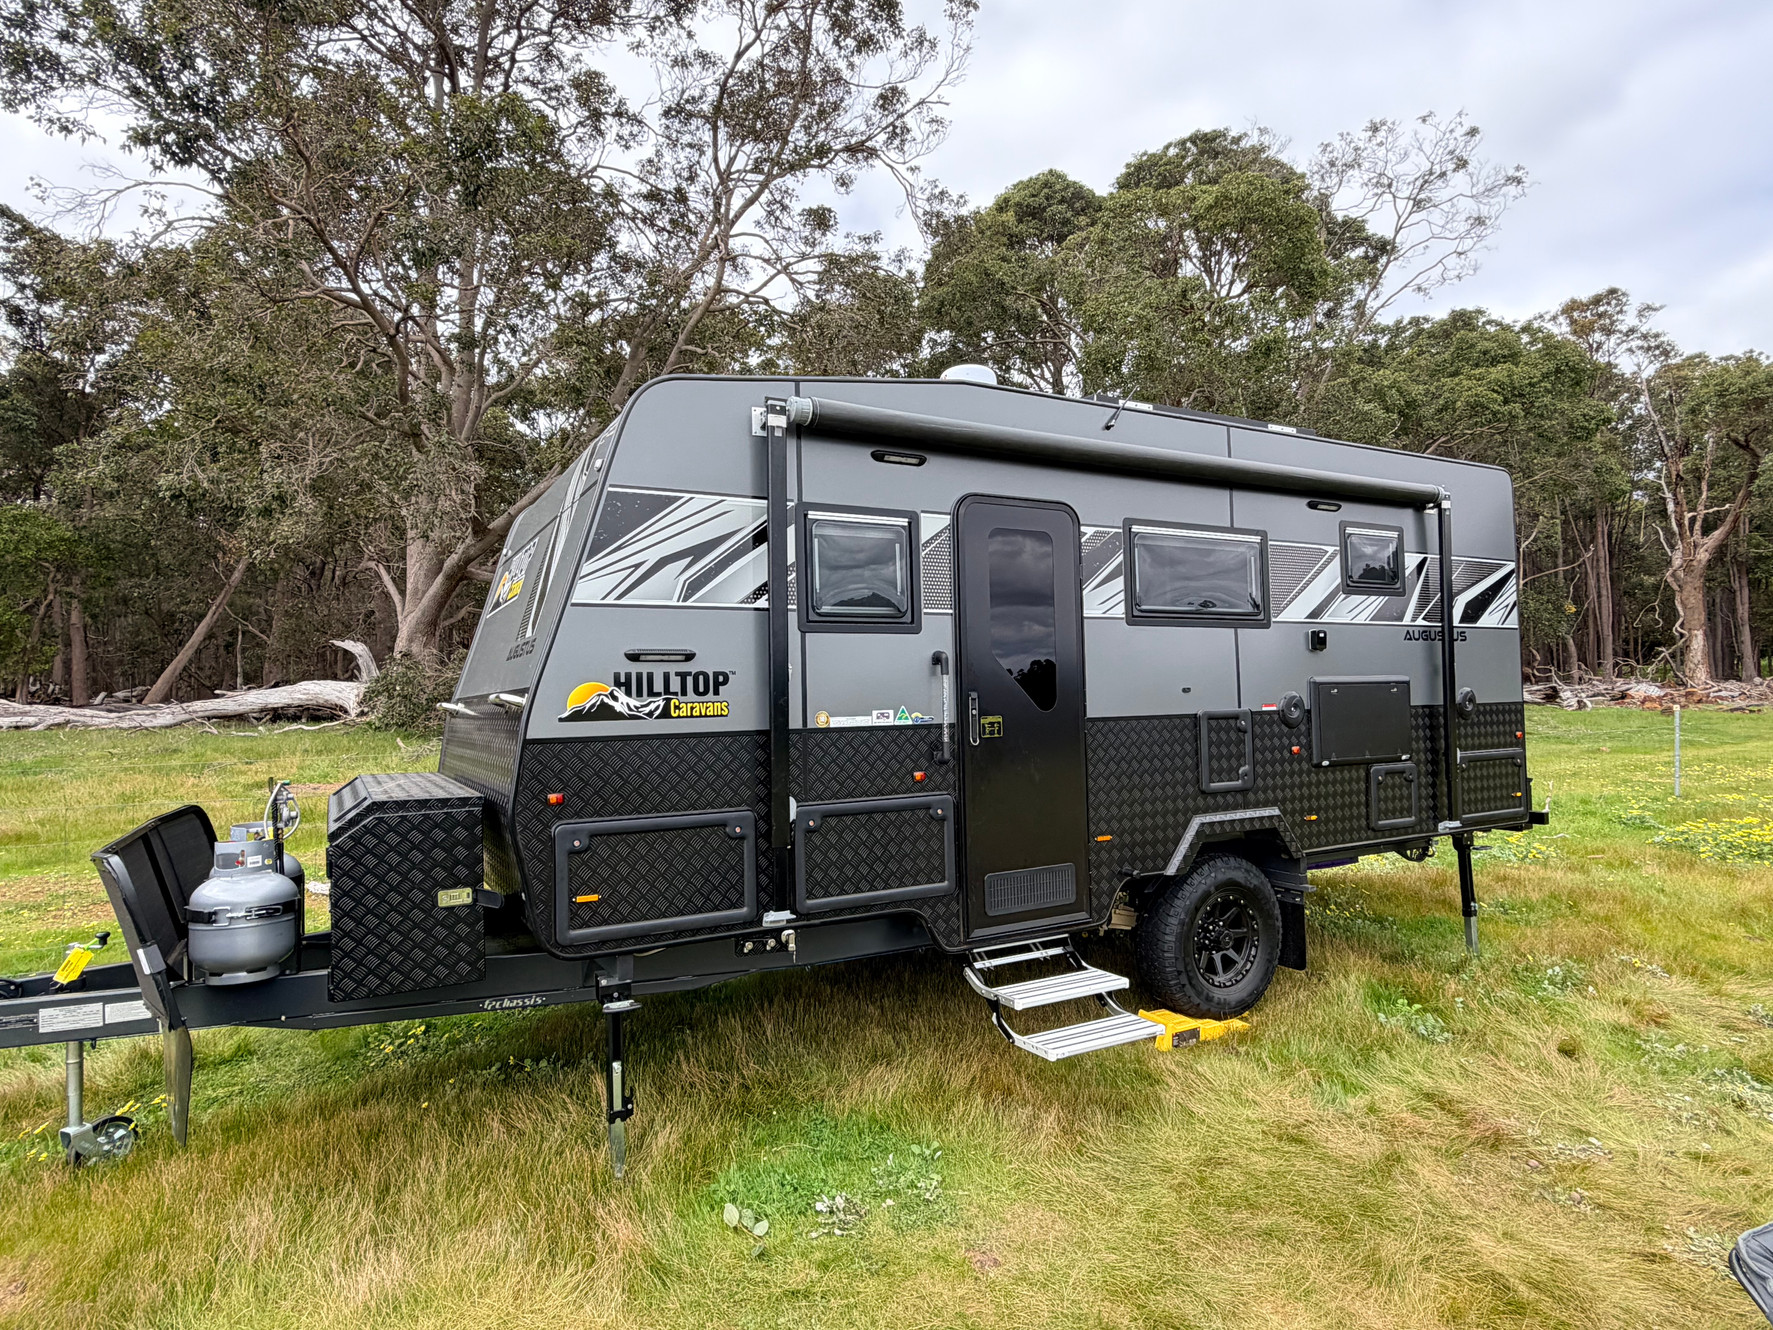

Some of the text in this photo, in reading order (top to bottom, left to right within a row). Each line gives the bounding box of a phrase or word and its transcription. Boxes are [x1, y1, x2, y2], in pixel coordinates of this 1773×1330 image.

[1403, 629, 1467, 642] AUGUSUS
[613, 671, 730, 698] HILLTOP
[670, 698, 729, 718] Caravans
